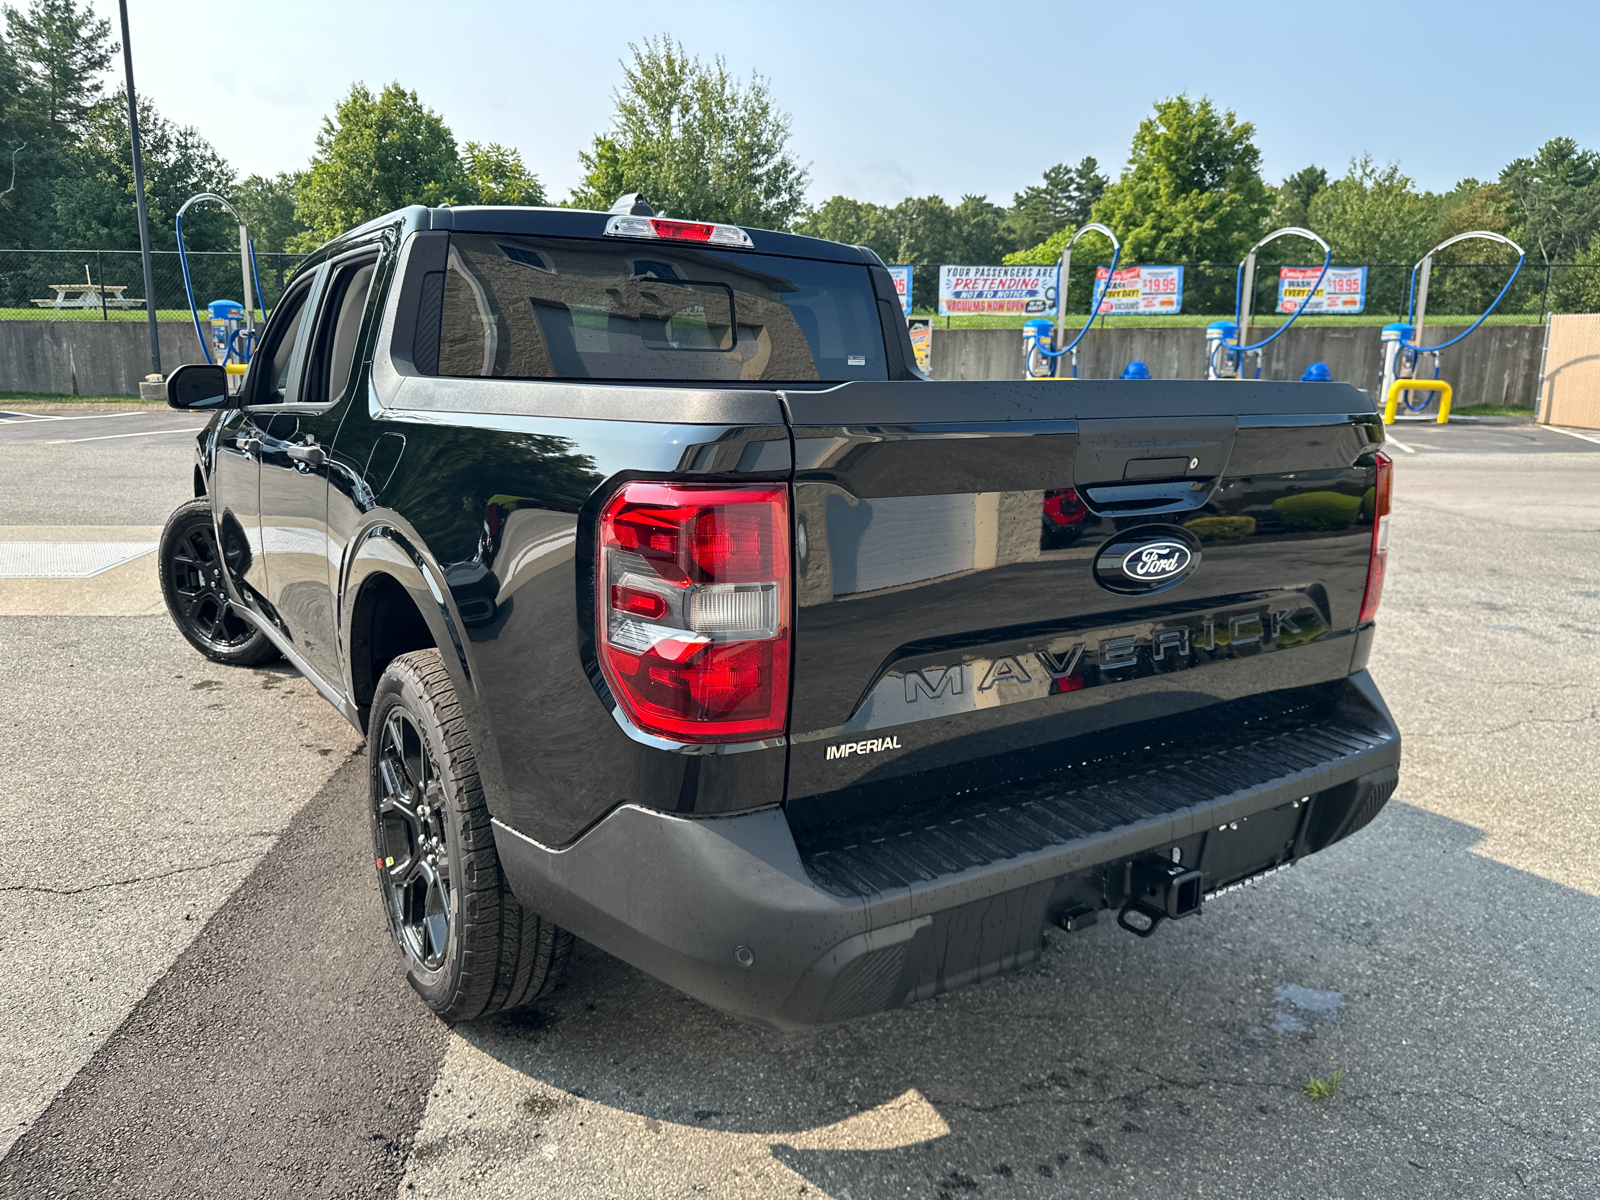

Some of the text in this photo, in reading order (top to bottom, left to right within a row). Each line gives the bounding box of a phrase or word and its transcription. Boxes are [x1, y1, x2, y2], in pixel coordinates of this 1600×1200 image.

[947, 268, 1054, 277] YOUR PASSENGERS ARE
[953, 278, 1039, 289] PRETENDING
[960, 291, 977, 299] NOT
[946, 300, 1026, 312] VACUUMS NOW OPEN
[1137, 548, 1179, 575] Ford
[903, 608, 1303, 704] MAVERICK
[825, 735, 902, 760] IMPERIAL
